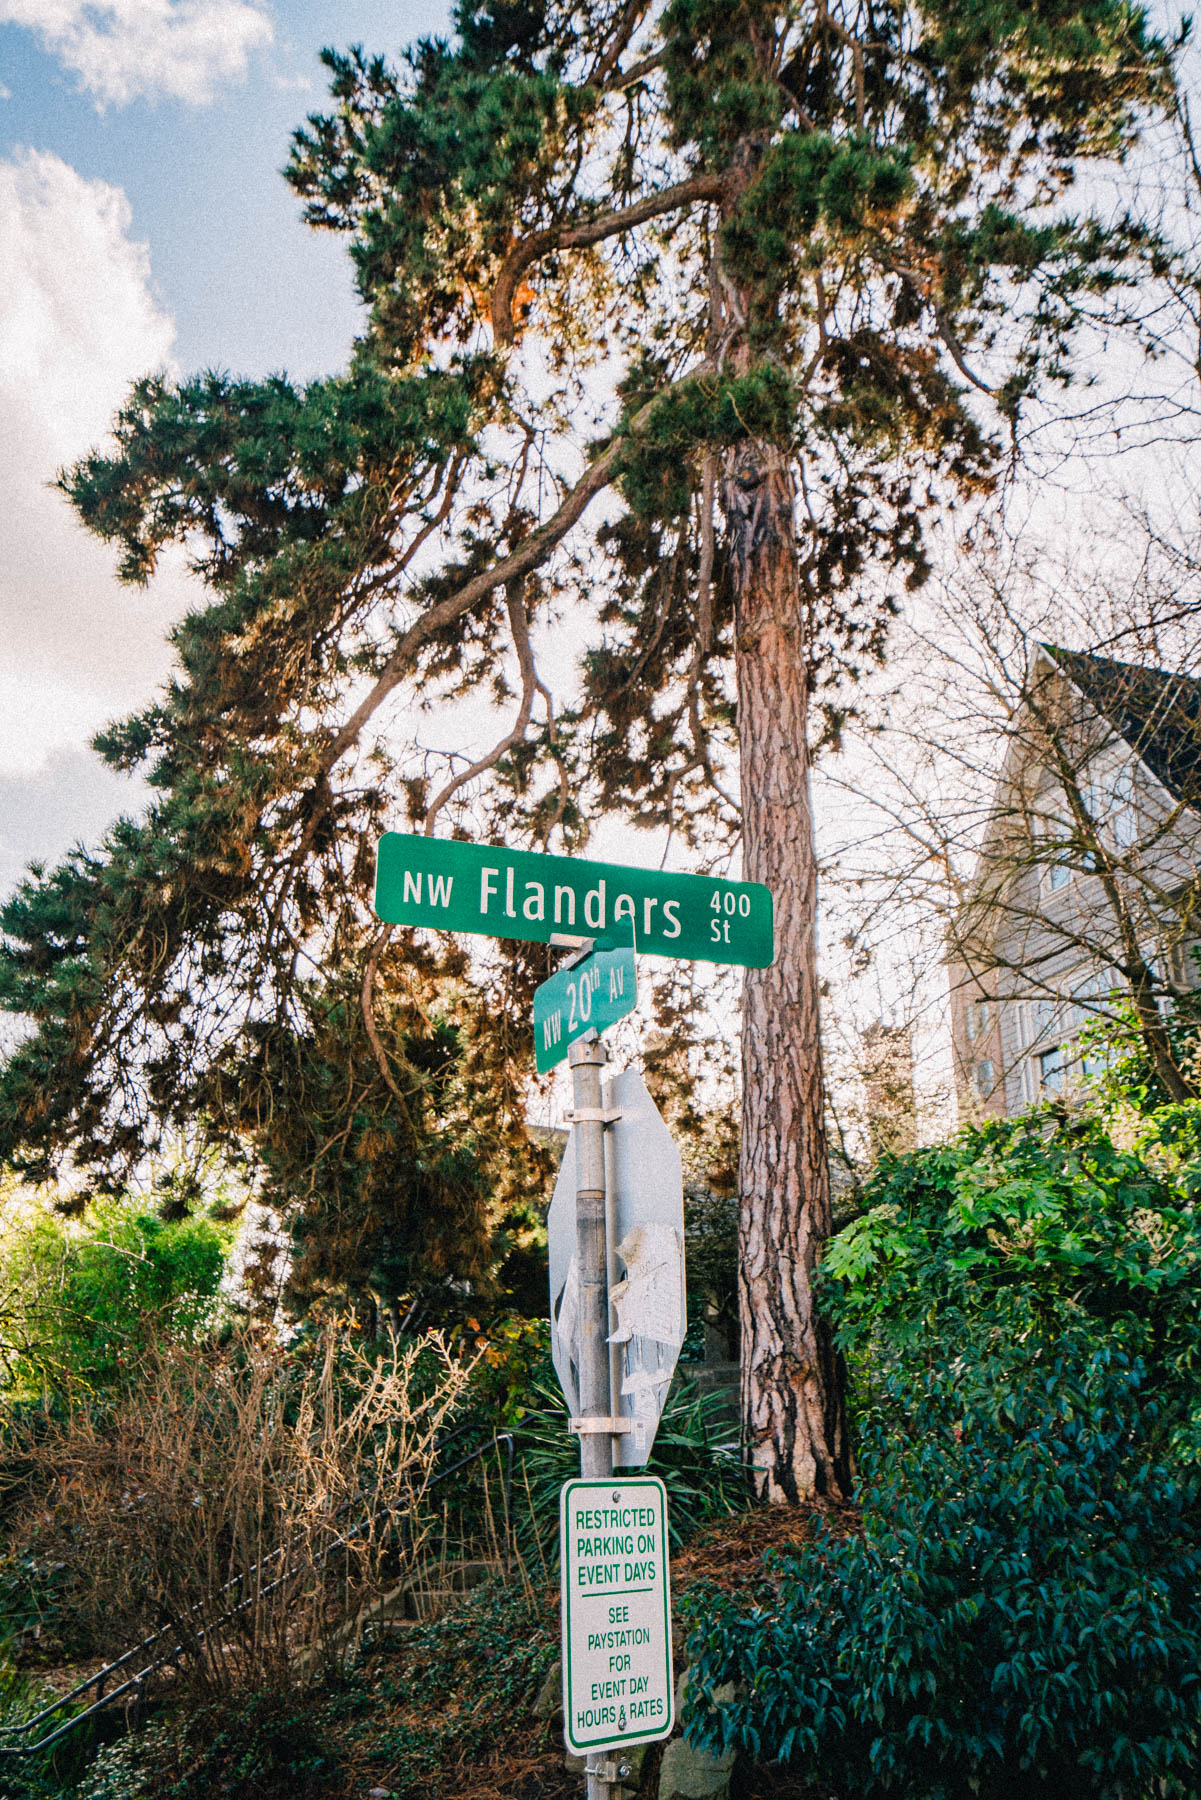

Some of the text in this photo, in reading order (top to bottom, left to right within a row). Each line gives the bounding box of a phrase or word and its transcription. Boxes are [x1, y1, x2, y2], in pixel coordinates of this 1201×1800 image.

[403, 866, 682, 938] NW Flanders
[710, 890, 751, 917] 400
[710, 918, 731, 944] St
[543, 1008, 562, 1051] NW
[609, 965, 624, 1004] AV
[576, 1508, 655, 1529] RESTRICTED
[577, 1534, 655, 1557] PARKING ON
[578, 1560, 656, 1586] EVENT DAYS
[608, 1606, 629, 1624] SEE
[588, 1627, 650, 1651] PAYSTATION
[609, 1654, 631, 1672] FOR
[591, 1675, 649, 1701] EVENT DAY
[577, 1705, 616, 1728] HOURS
[629, 1697, 664, 1719] RATES
